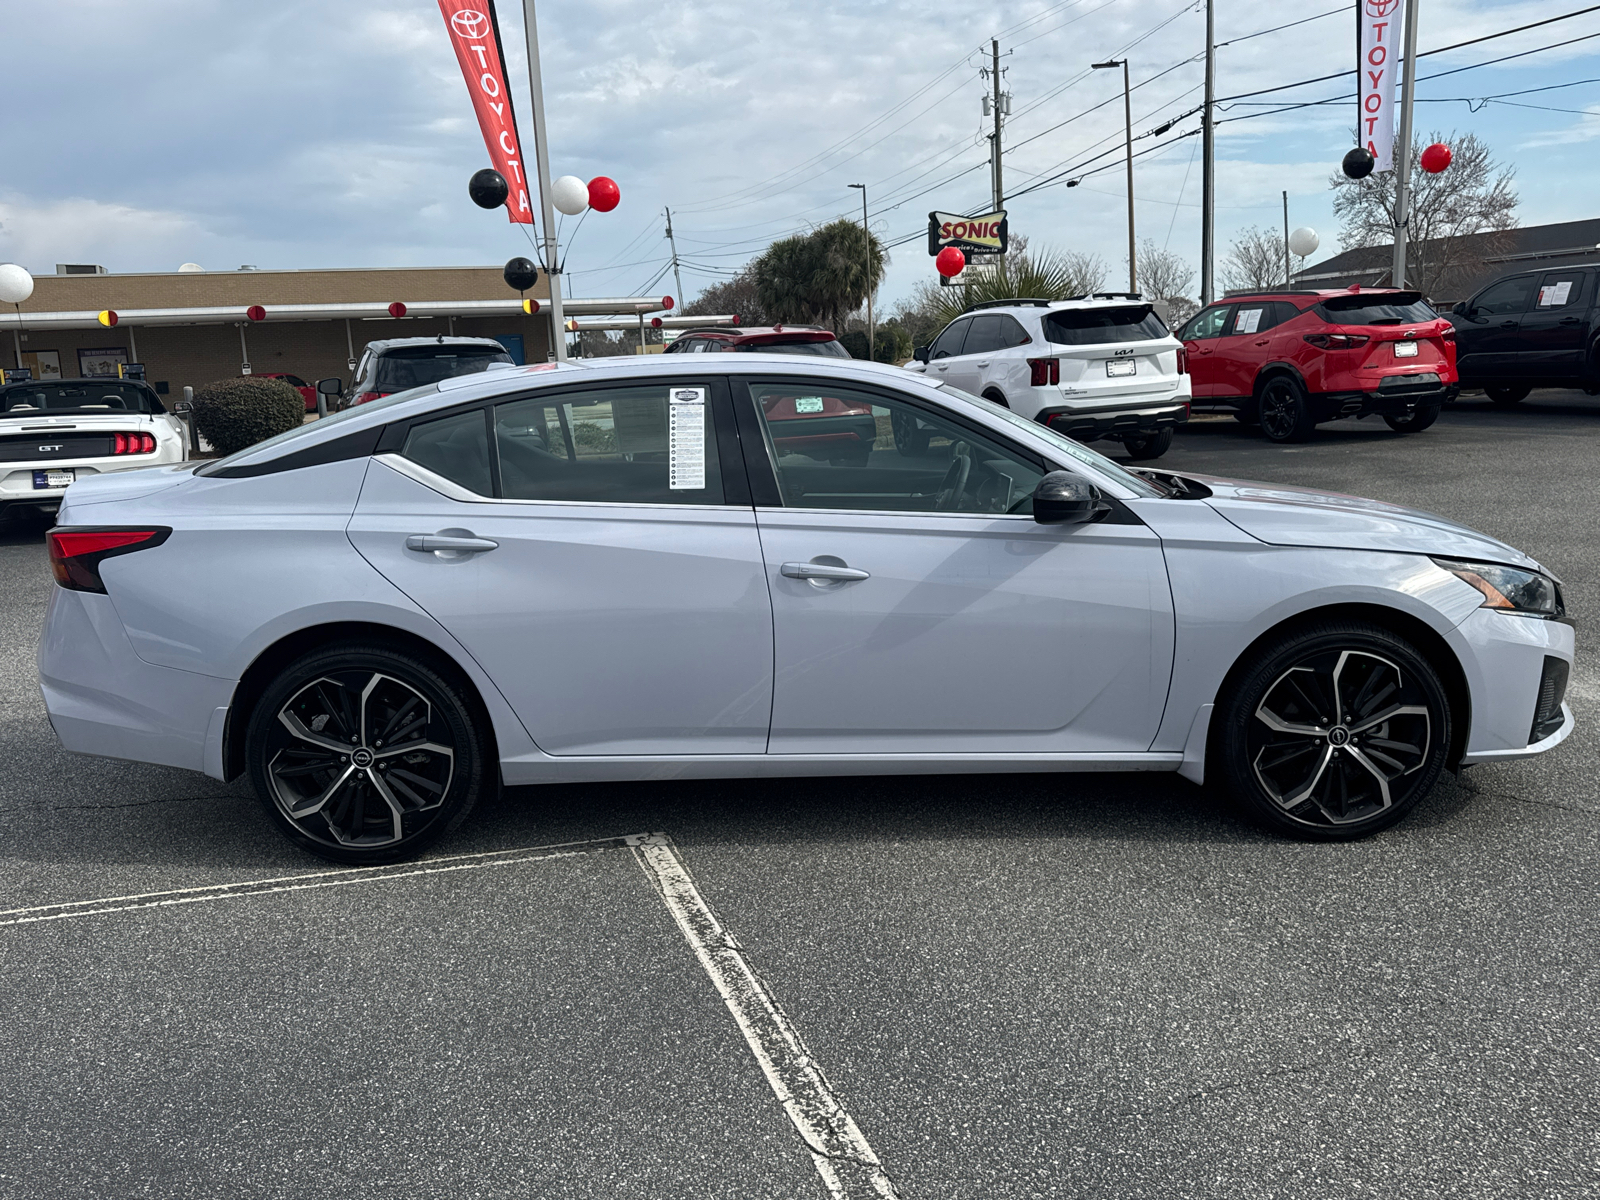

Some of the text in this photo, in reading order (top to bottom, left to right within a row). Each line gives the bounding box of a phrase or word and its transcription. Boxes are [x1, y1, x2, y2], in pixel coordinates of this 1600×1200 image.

[471, 45, 530, 213] TOYOTA
[1364, 22, 1388, 158] TOYOTA
[941, 221, 1000, 239] SONIC
